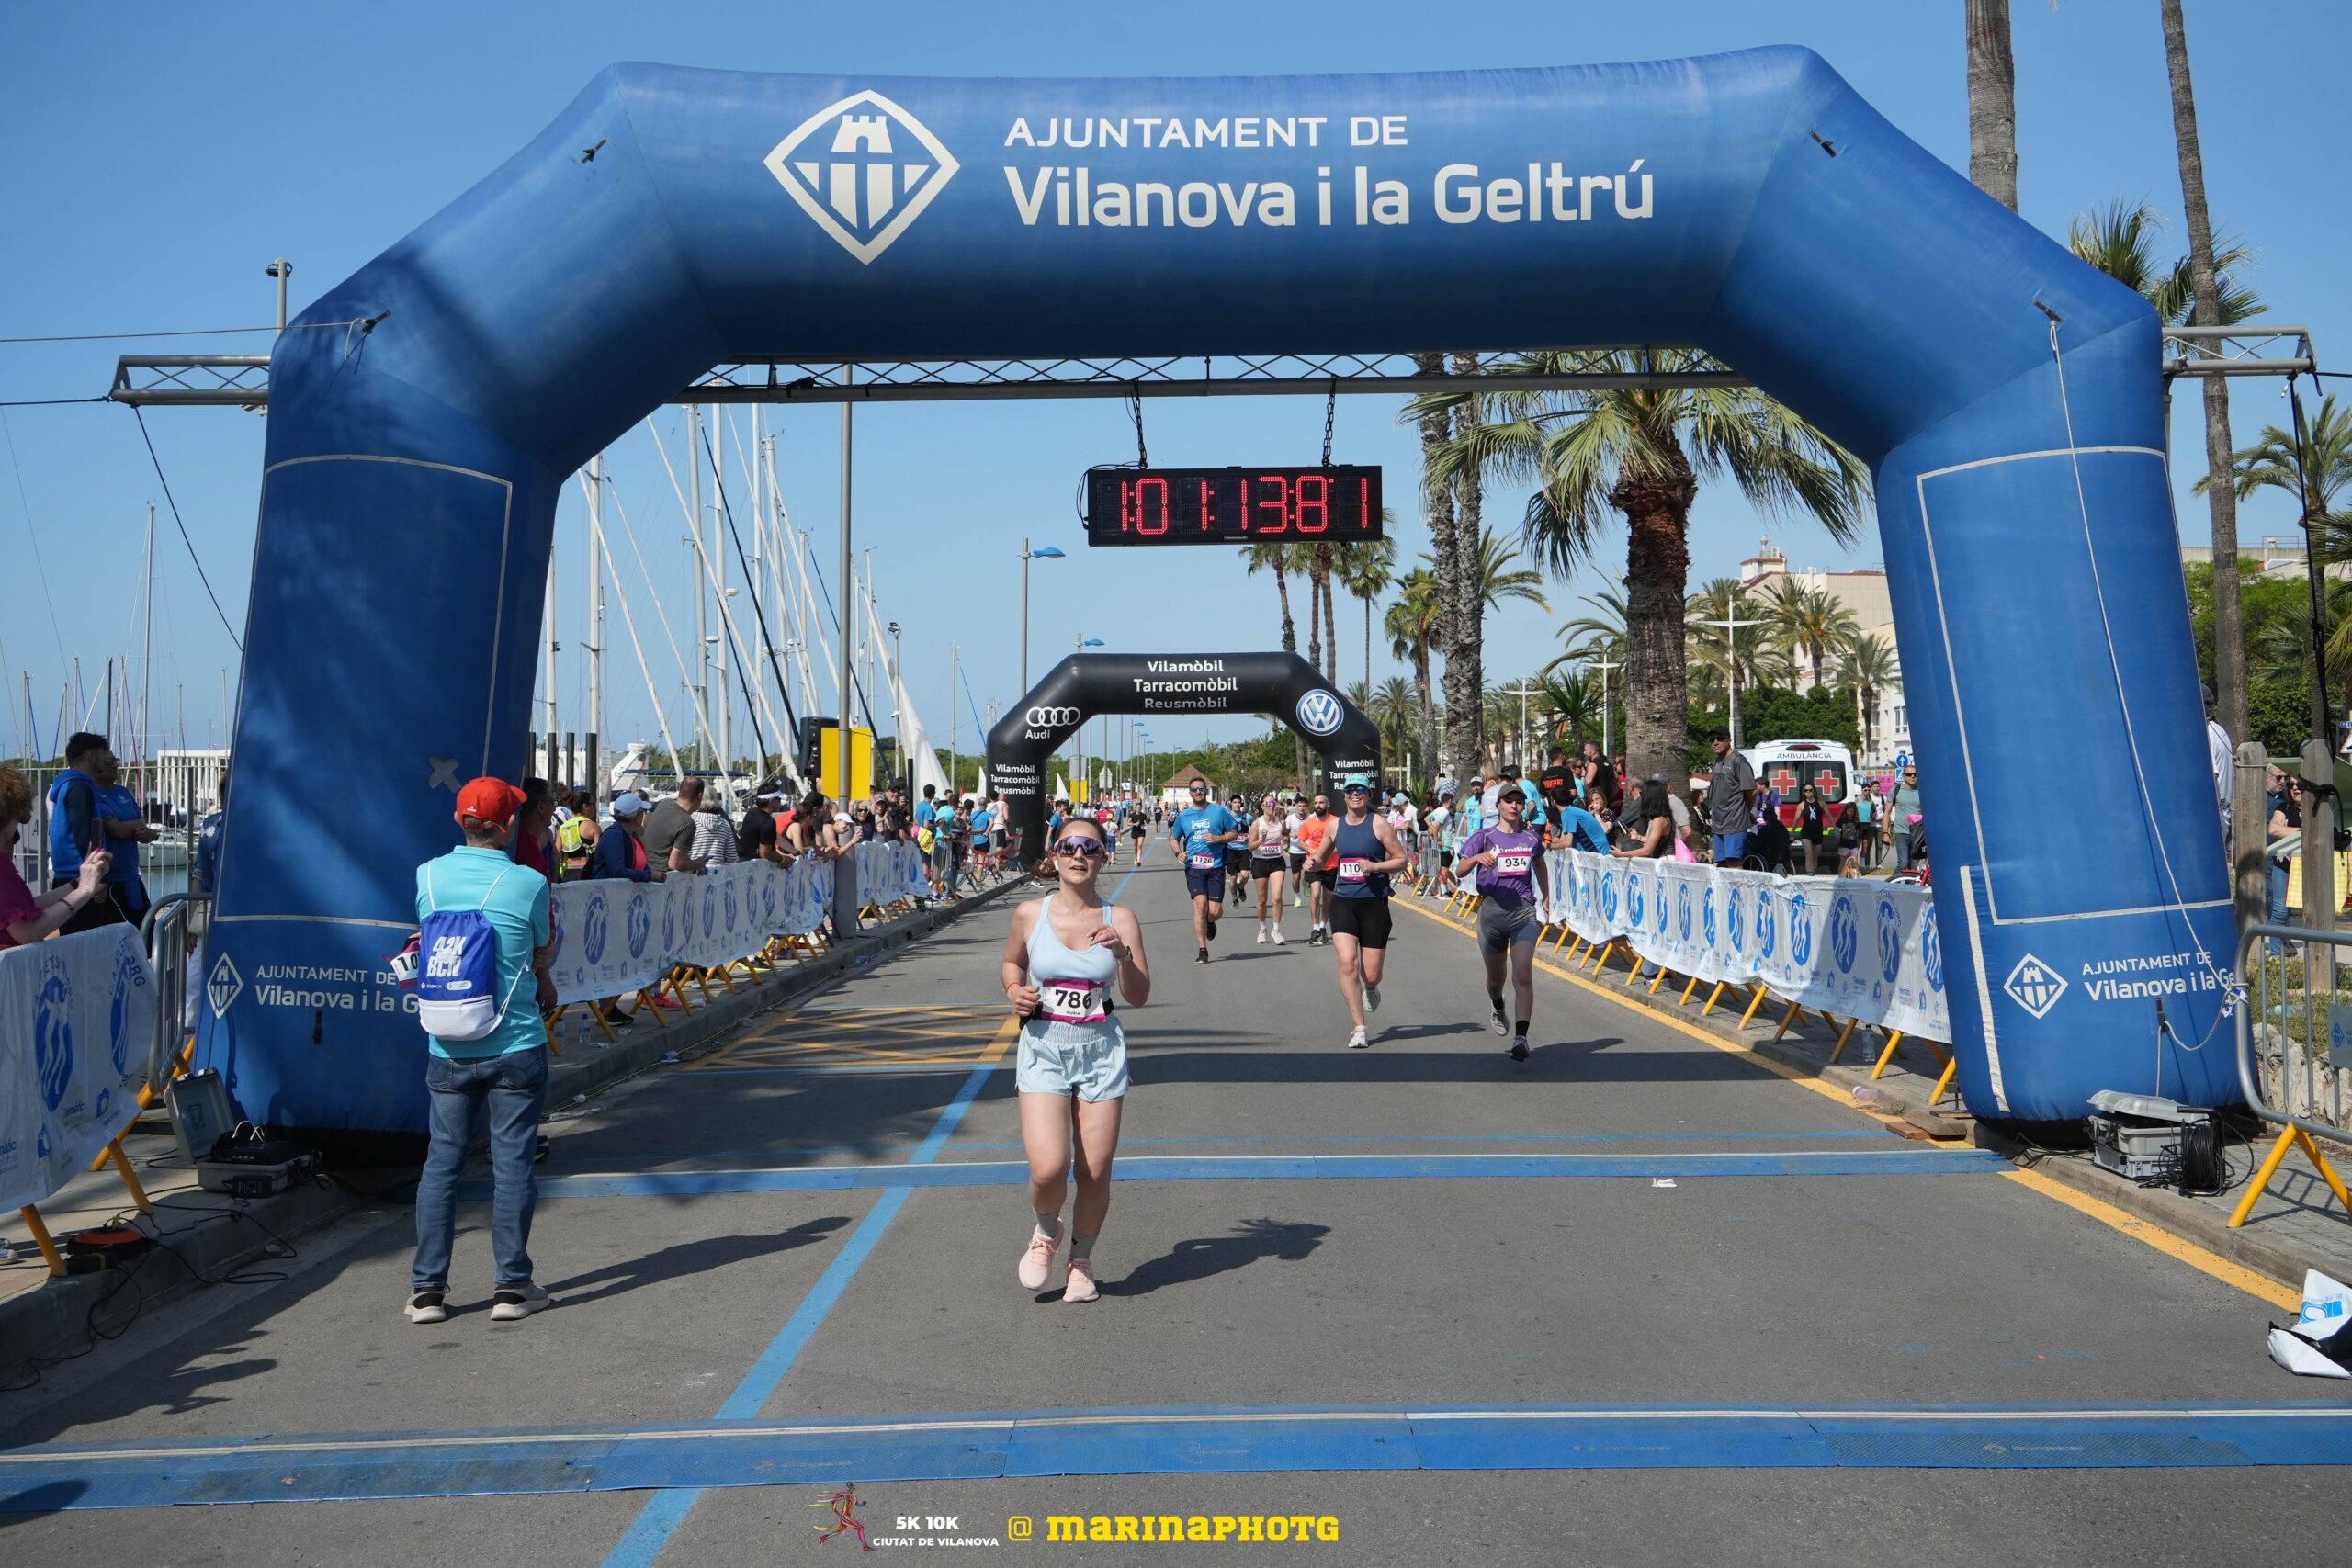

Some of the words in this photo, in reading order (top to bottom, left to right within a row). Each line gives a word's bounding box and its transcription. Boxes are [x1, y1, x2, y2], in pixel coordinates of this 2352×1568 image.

[1004, 116, 1328, 149] AJUNTAMENT
[1351, 115, 1408, 147] DE
[1004, 165, 1295, 229] Vilanova
[1318, 166, 1332, 227] i
[1355, 165, 1409, 226] la
[1434, 159, 1655, 225] Geltrú
[1147, 660, 1224, 672] Vilamòbil
[1133, 677, 1238, 693] Tarracomòbil
[1144, 696, 1227, 709] Reusmòbil
[1024, 728, 1051, 739] Audi
[995, 763, 1035, 773] Vilamòbil
[1335, 759, 1374, 769] Vilamòbil
[990, 774, 1040, 784] Tarracomòbil
[1194, 855, 1213, 864] 1126
[1505, 857, 1527, 867] 934
[1342, 863, 1361, 874] 110
[432, 936, 468, 956] 42K
[2082, 953, 2191, 976] AJUNTAMENT
[2196, 952, 2212, 965] DE
[255, 965, 369, 984] AJUNTAMENT
[375, 971, 398, 986] DE
[2084, 976, 2188, 1001] Vilanova
[2190, 972, 2197, 992] i
[2199, 970, 2217, 991] la
[254, 984, 355, 1010] Vilanova
[361, 989, 368, 1010] i
[374, 990, 395, 1012] la
[1055, 988, 1092, 1010] 786
